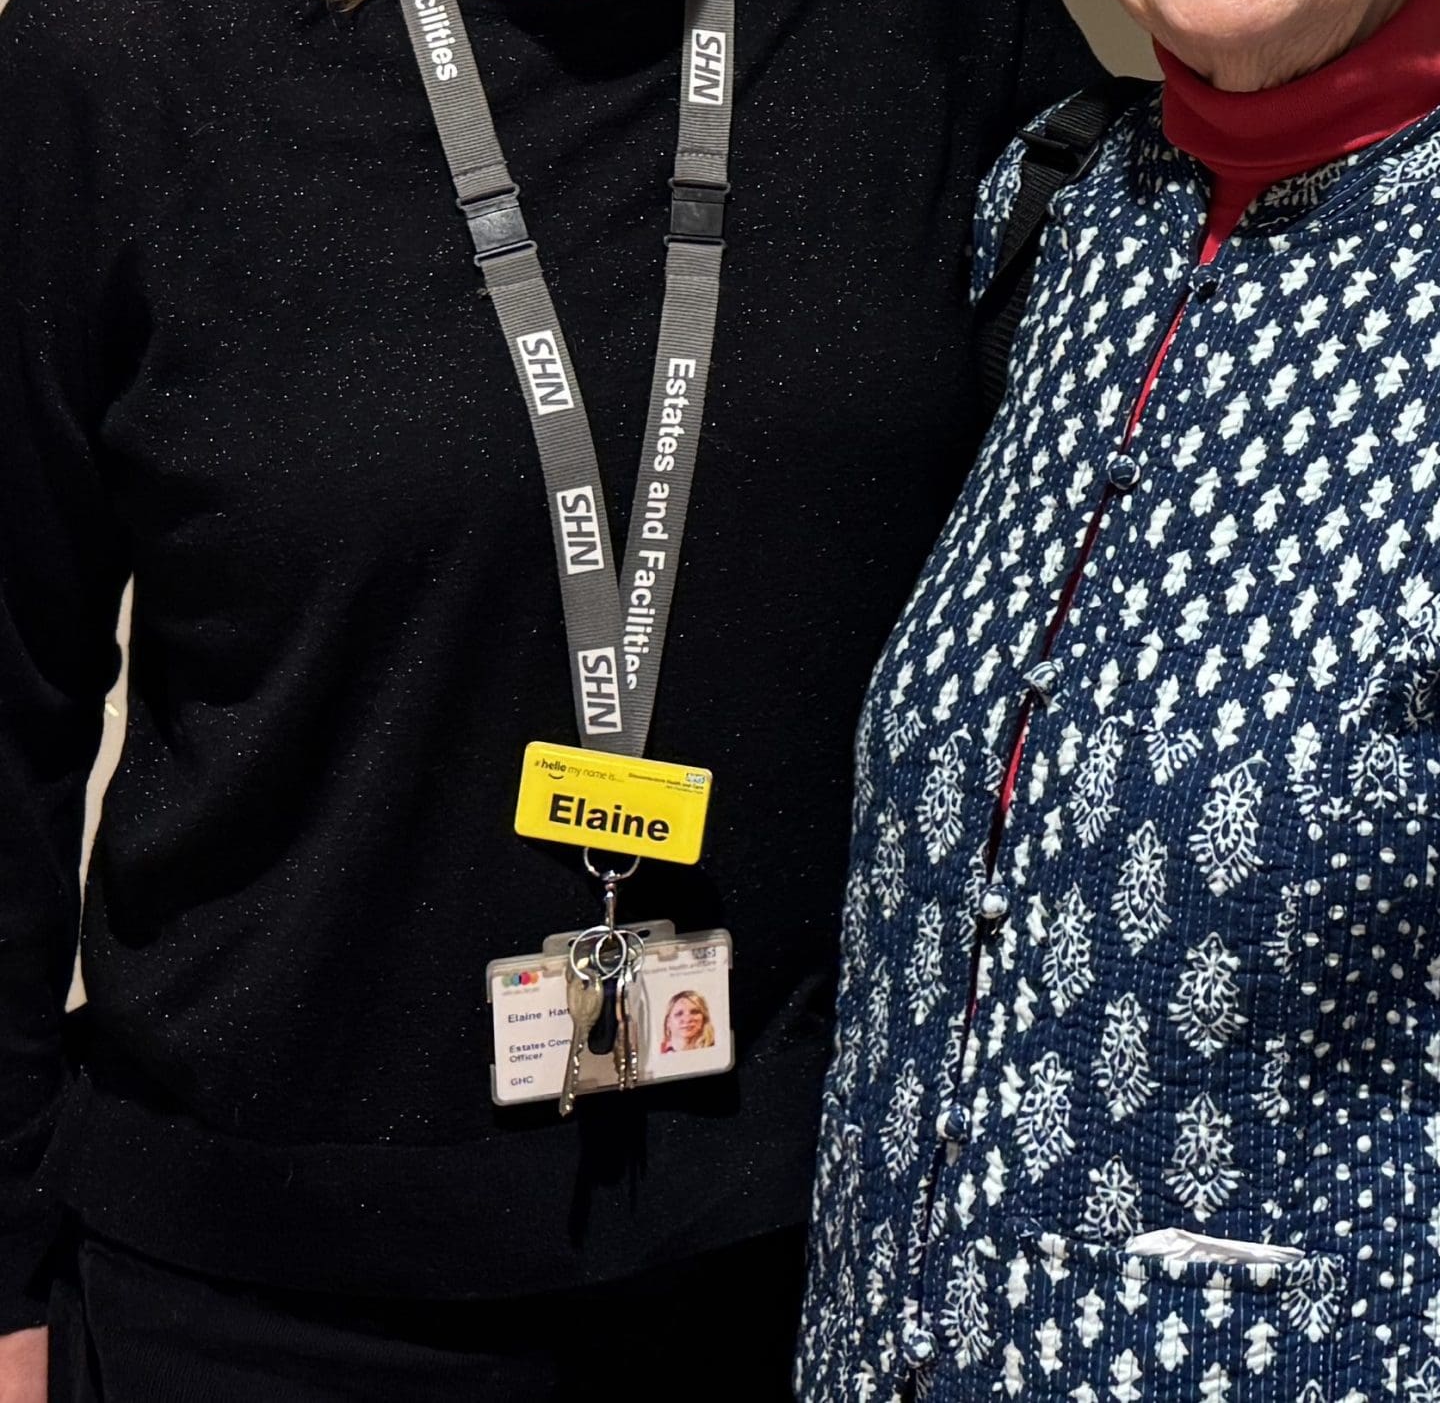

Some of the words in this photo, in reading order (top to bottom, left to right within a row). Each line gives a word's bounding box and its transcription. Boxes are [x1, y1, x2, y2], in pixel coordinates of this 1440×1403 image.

[693, 33, 722, 102] NHS
[521, 336, 570, 411] NHS
[653, 358, 696, 472] Estates
[561, 492, 600, 568] NHS
[642, 481, 670, 540] and
[582, 654, 618, 730] NHS
[567, 766, 582, 777] my
[583, 768, 607, 780] name
[548, 793, 670, 842] Elaine
[508, 1012, 542, 1023] Elaine
[509, 1042, 546, 1053] Estates
[509, 1053, 543, 1063] Officer
